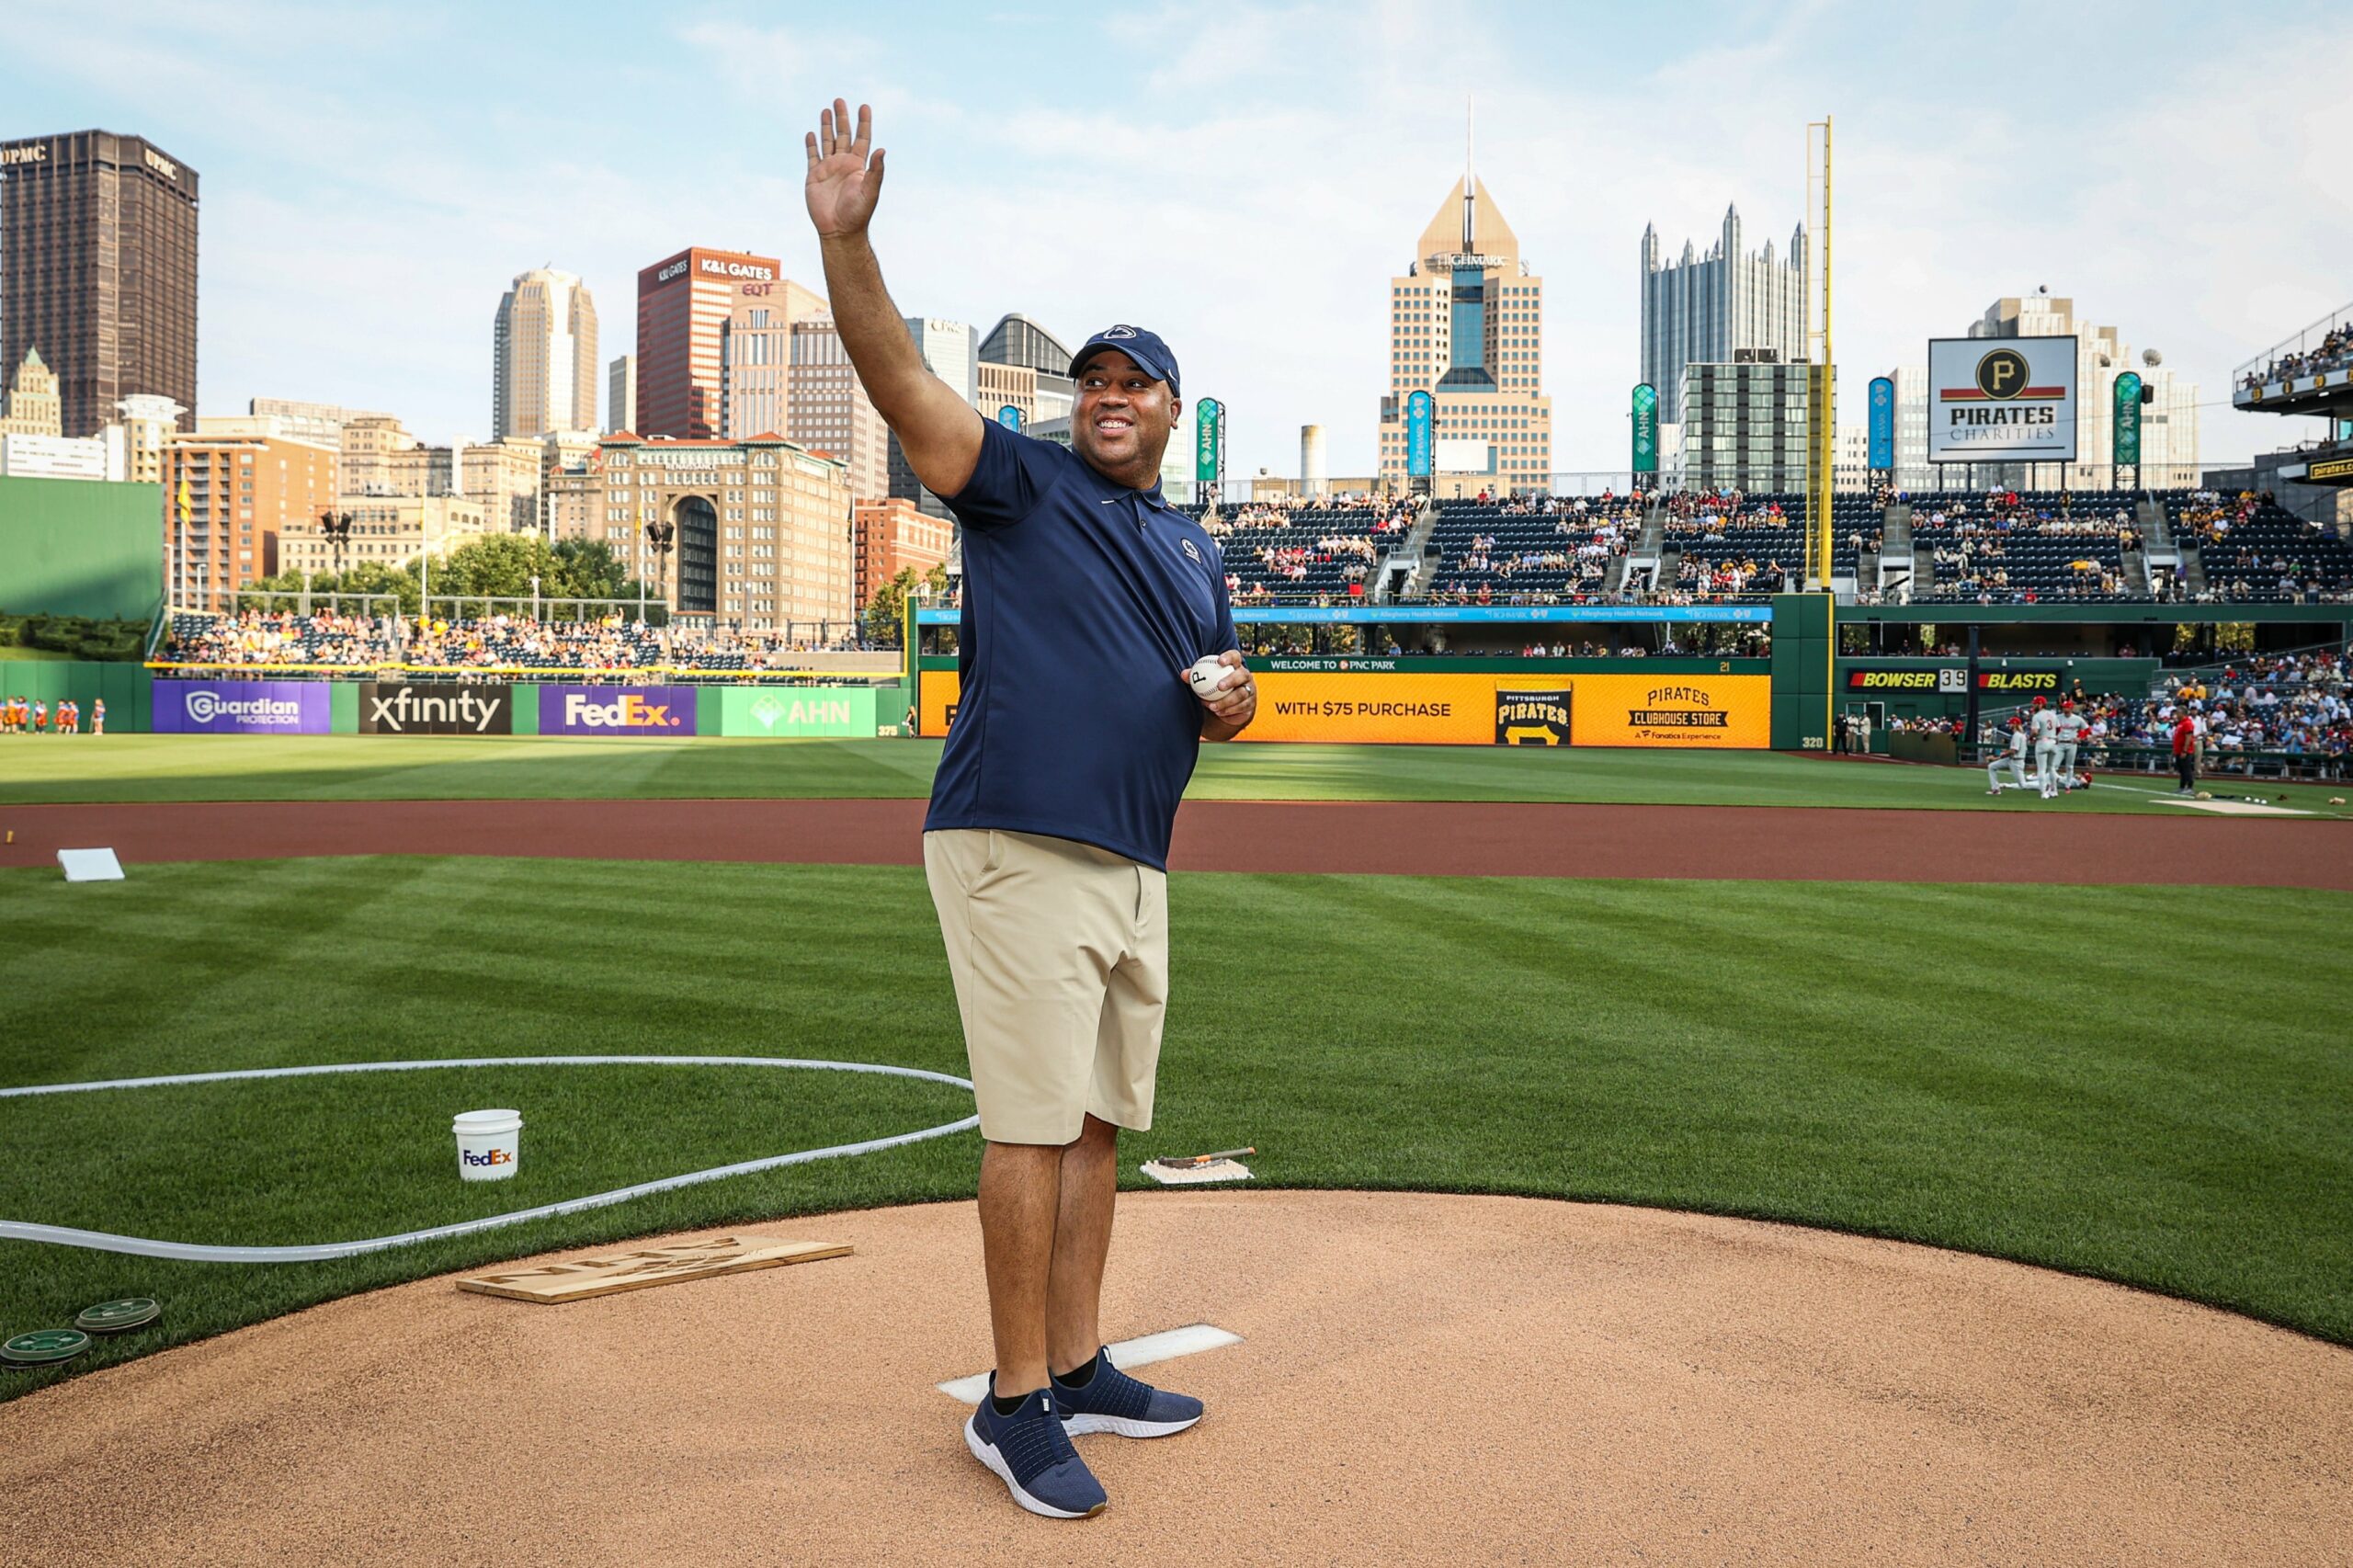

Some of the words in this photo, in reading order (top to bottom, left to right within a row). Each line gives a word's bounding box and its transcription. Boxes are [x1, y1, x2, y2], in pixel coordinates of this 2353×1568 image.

[0, 145, 46, 165] UPMC
[144, 148, 177, 181] UPMC
[700, 258, 728, 276] K&L
[729, 259, 772, 281] GATES
[742, 282, 773, 297] EQT
[1950, 407, 2054, 426] PIRATES
[2121, 401, 2134, 430] AHN
[1638, 411, 1650, 439] AHN
[1949, 426, 2054, 440] CHARITIES
[1201, 424, 1213, 450] AHN
[1270, 660, 1321, 670] WELCOME
[1323, 660, 1337, 670] TO
[1349, 661, 1370, 670] PNC
[1370, 661, 1395, 670] PARK
[1720, 661, 1730, 672] 21
[1862, 673, 1937, 687] BOWSER
[1987, 673, 2057, 688] BLASTS
[1646, 687, 1711, 706] PIRATES
[193, 697, 299, 715] Guardian
[369, 687, 502, 732] xfinity
[788, 700, 851, 724] AHN
[1275, 702, 1318, 715] WITH
[1323, 701, 1353, 717] $75
[1358, 703, 1451, 716] PURCHASE
[1498, 702, 1568, 725] PIRATES
[1633, 712, 1689, 726] CLUBHOUSE
[1690, 712, 1722, 726] STORE
[2046, 719, 2053, 731] 3
[878, 724, 898, 736] 375
[1681, 733, 1722, 741] Experience
[1802, 736, 1824, 749] 320
